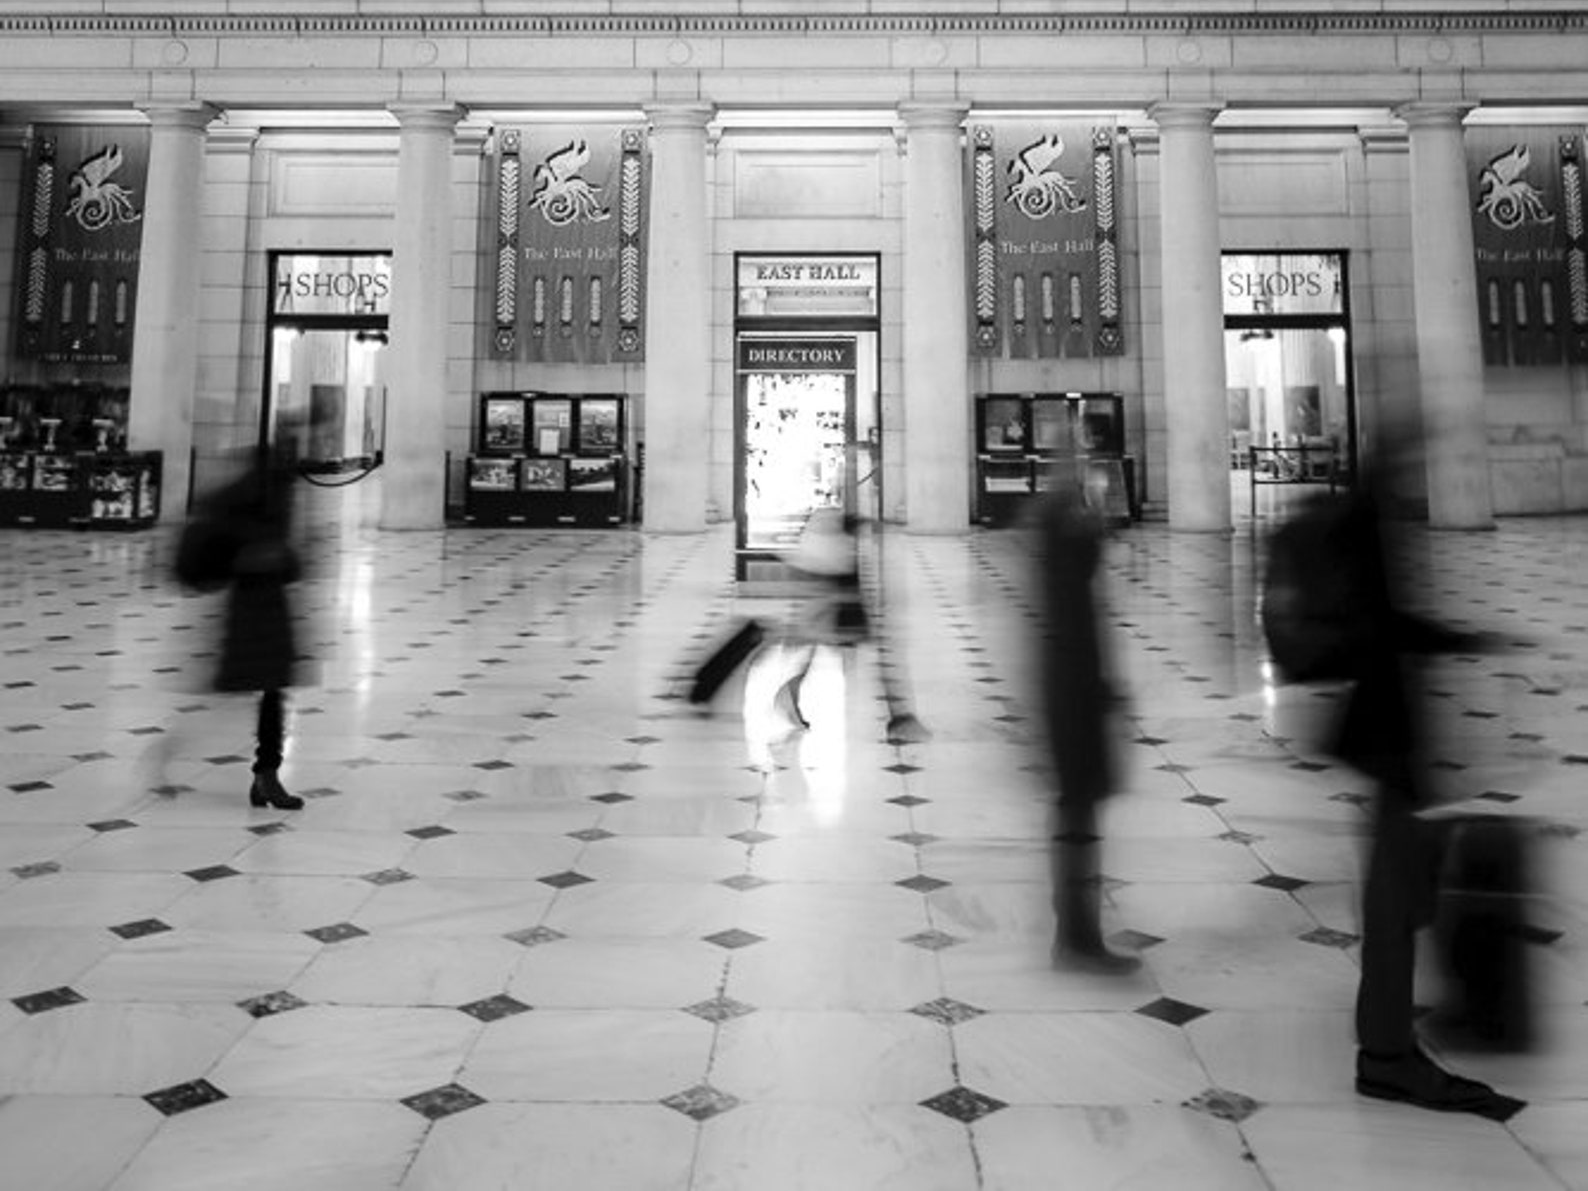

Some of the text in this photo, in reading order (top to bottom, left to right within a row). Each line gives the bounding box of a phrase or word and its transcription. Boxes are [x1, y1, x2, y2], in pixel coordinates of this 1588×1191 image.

[524, 246, 548, 261] The
[553, 246, 582, 260] East
[1000, 240, 1027, 254] The
[1029, 240, 1058, 254] East
[756, 264, 861, 280] EAST HALL
[295, 273, 389, 298] SHOPS
[1228, 272, 1322, 297] SHOPS
[748, 348, 846, 363] DIRECTORY
